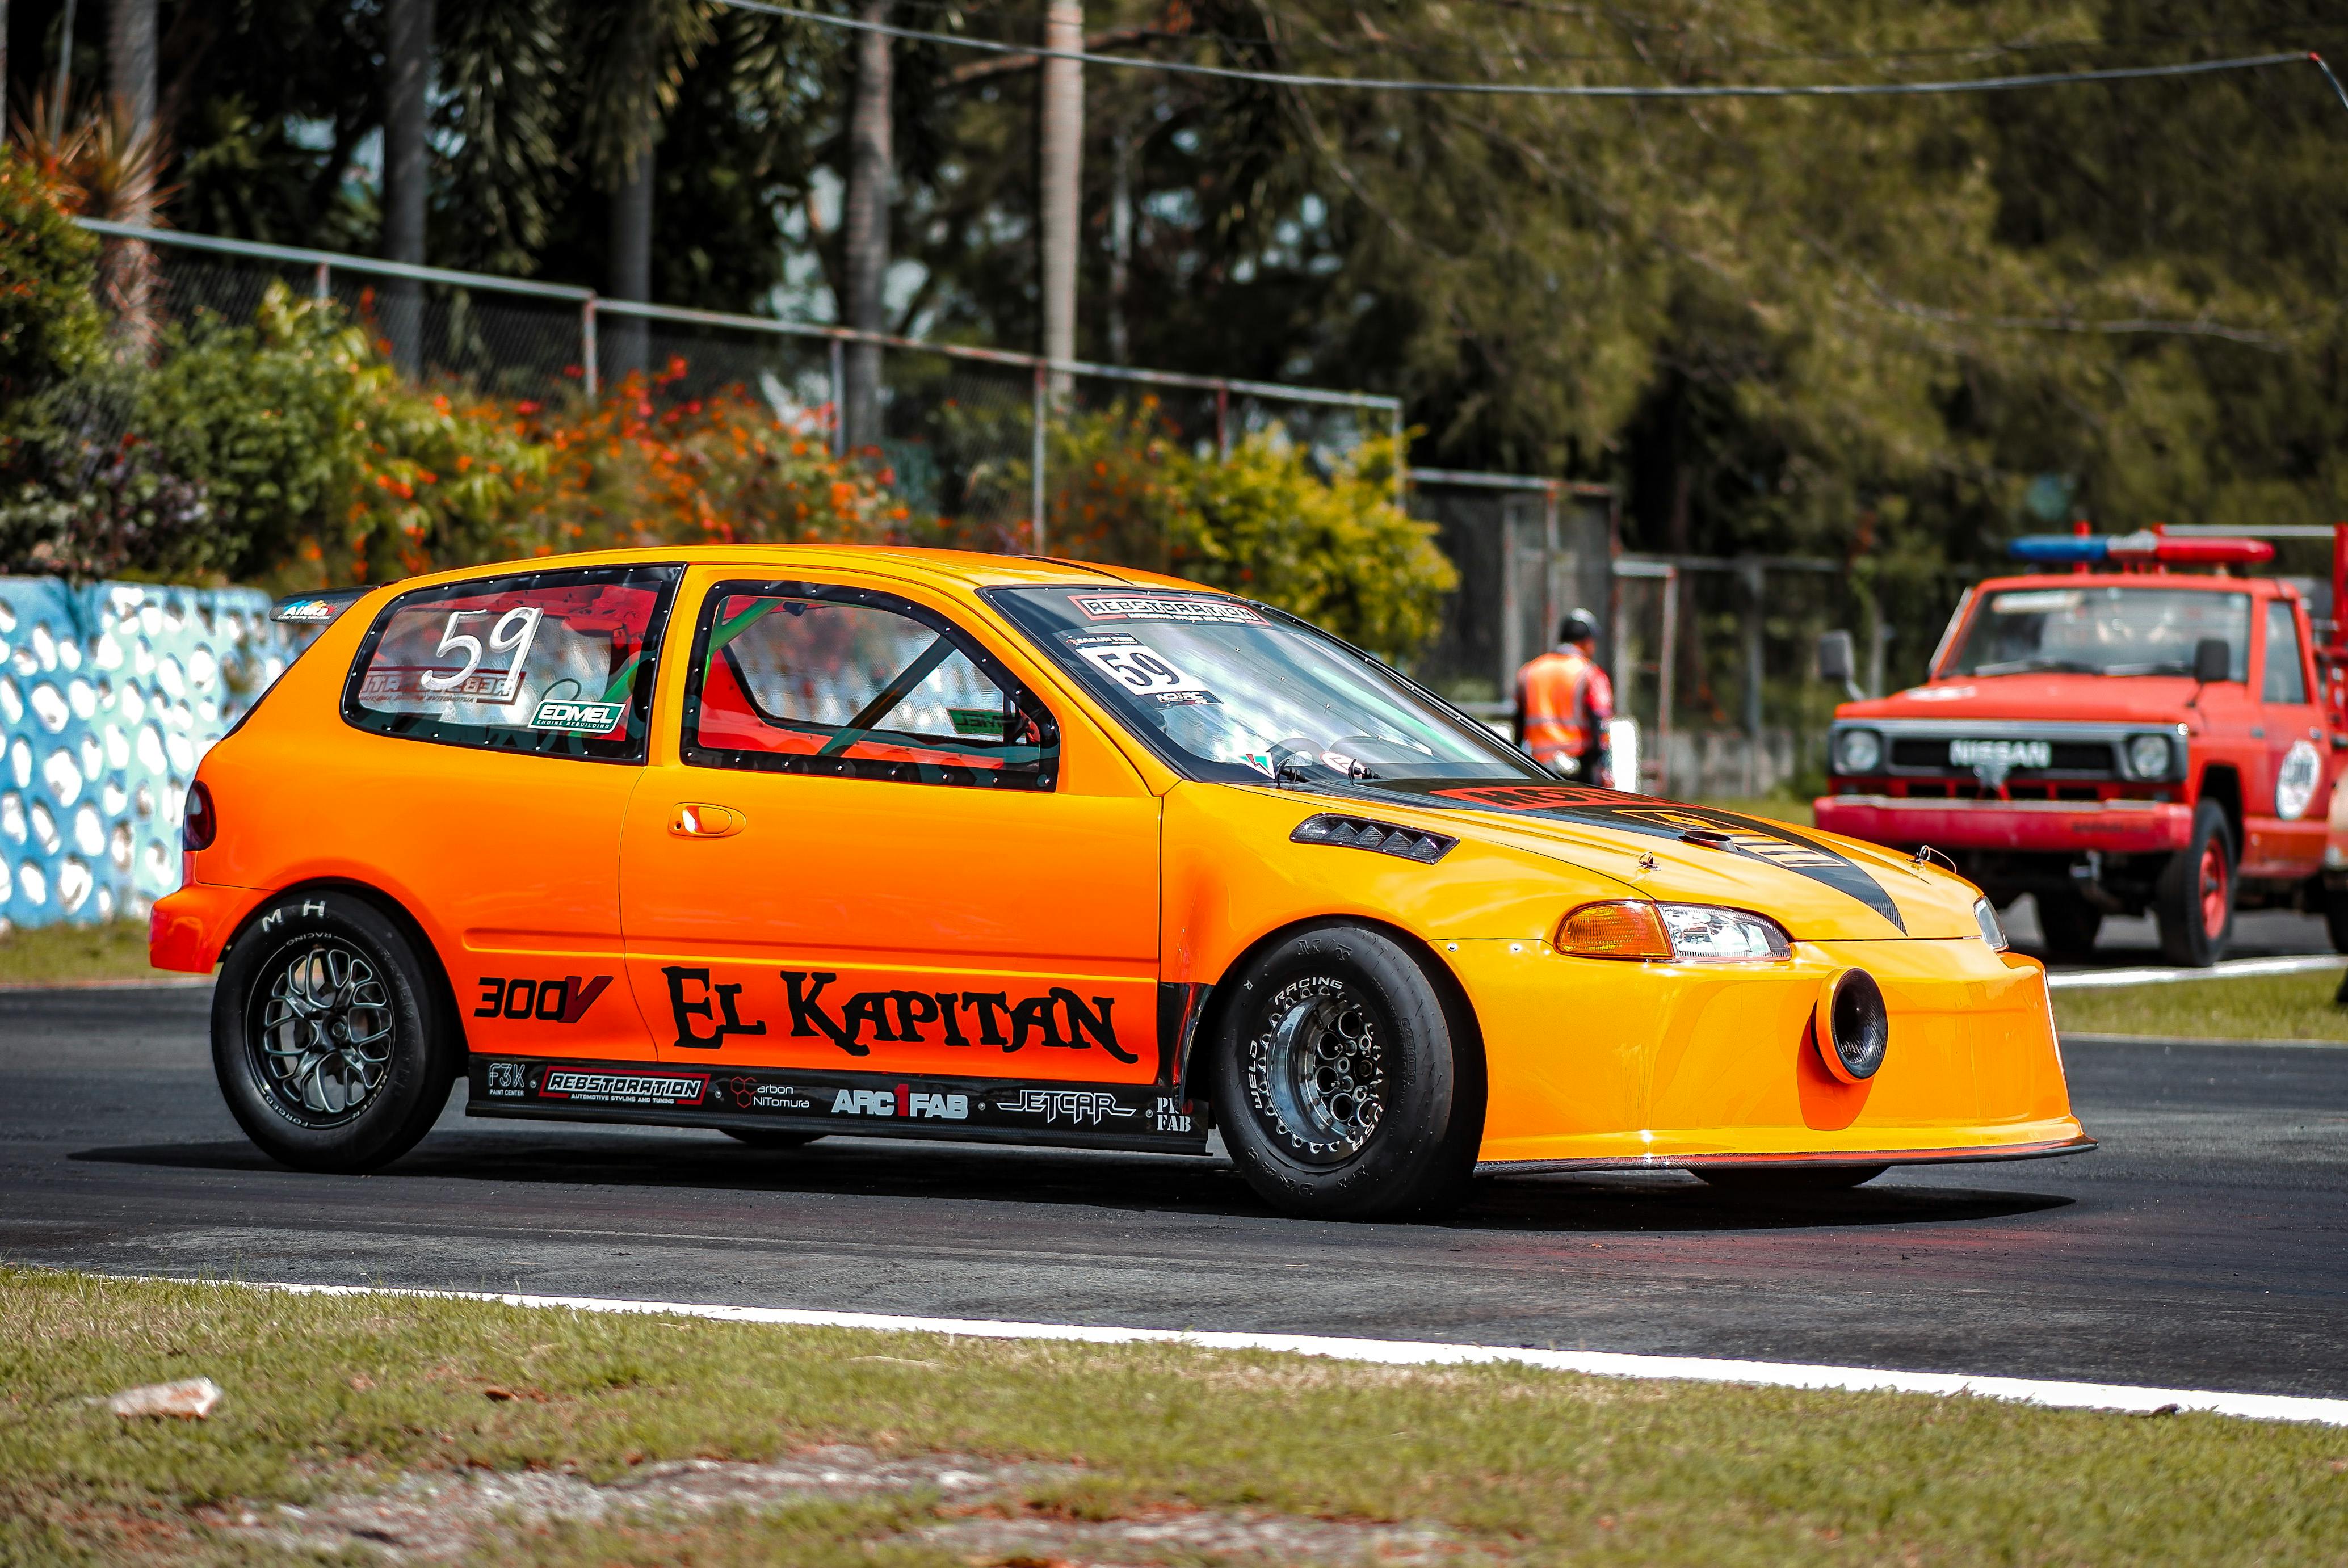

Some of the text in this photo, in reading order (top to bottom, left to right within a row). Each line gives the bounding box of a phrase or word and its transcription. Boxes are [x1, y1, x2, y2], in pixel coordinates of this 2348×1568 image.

[1081, 598, 1260, 621] REBSTORATION
[421, 606, 544, 692] 59
[1098, 653, 1180, 686] 59
[539, 704, 614, 724] EDMEL
[1950, 739, 2052, 767] NISSAN
[286, 932, 332, 947] RACING
[473, 976, 614, 1023] 300V
[1274, 976, 1343, 1006] RACING
[489, 1063, 525, 1088] F3K
[547, 1072, 702, 1098] REBSTORATION
[1249, 1040, 1262, 1109] WELD
[266, 1096, 310, 1128] FORGED
[996, 1089, 1137, 1125] JETCAR
[1157, 1115, 1191, 1132] FAB
[1352, 1102, 1383, 1151] USA
